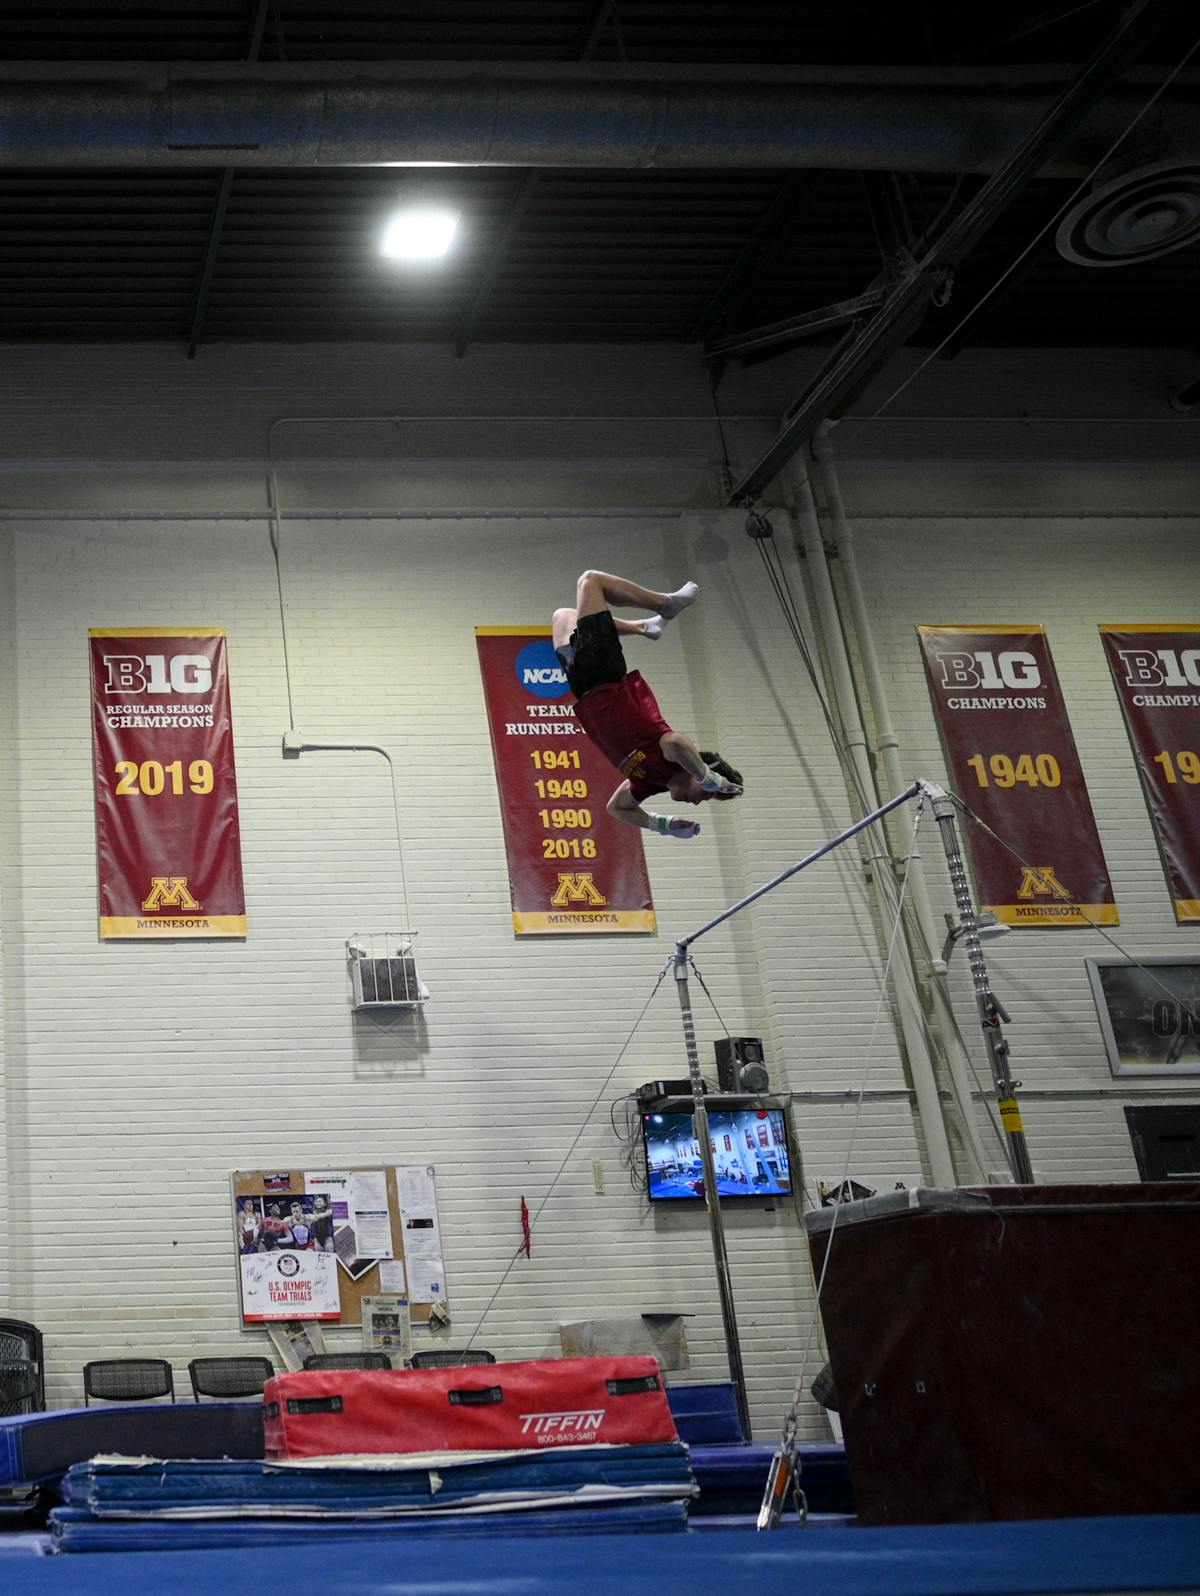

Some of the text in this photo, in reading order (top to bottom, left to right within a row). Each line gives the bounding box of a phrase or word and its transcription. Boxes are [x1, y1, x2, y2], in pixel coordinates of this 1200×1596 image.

[947, 696, 1047, 710] CHAMPIONS
[1132, 694, 1200, 707] CHAMPI
[106, 703, 214, 715] REGULAR SEASON
[526, 704, 576, 717] TEAM
[107, 715, 214, 729] CHAMPIONS
[530, 750, 581, 769] 1941
[114, 759, 215, 796] 2019
[967, 753, 1062, 788] 1940
[534, 779, 588, 799] 1949
[538, 809, 592, 829] 1990
[542, 839, 597, 859] 2018
[141, 876, 199, 911] M
[551, 873, 607, 906] M
[136, 919, 210, 929] MINNESOTA
[548, 914, 618, 923] MINNESOTA
[268, 1280, 312, 1291] U.S. OLYMPIC
[269, 1291, 312, 1302] TEAM TRIALS
[519, 1409, 606, 1434] TIFFIN
